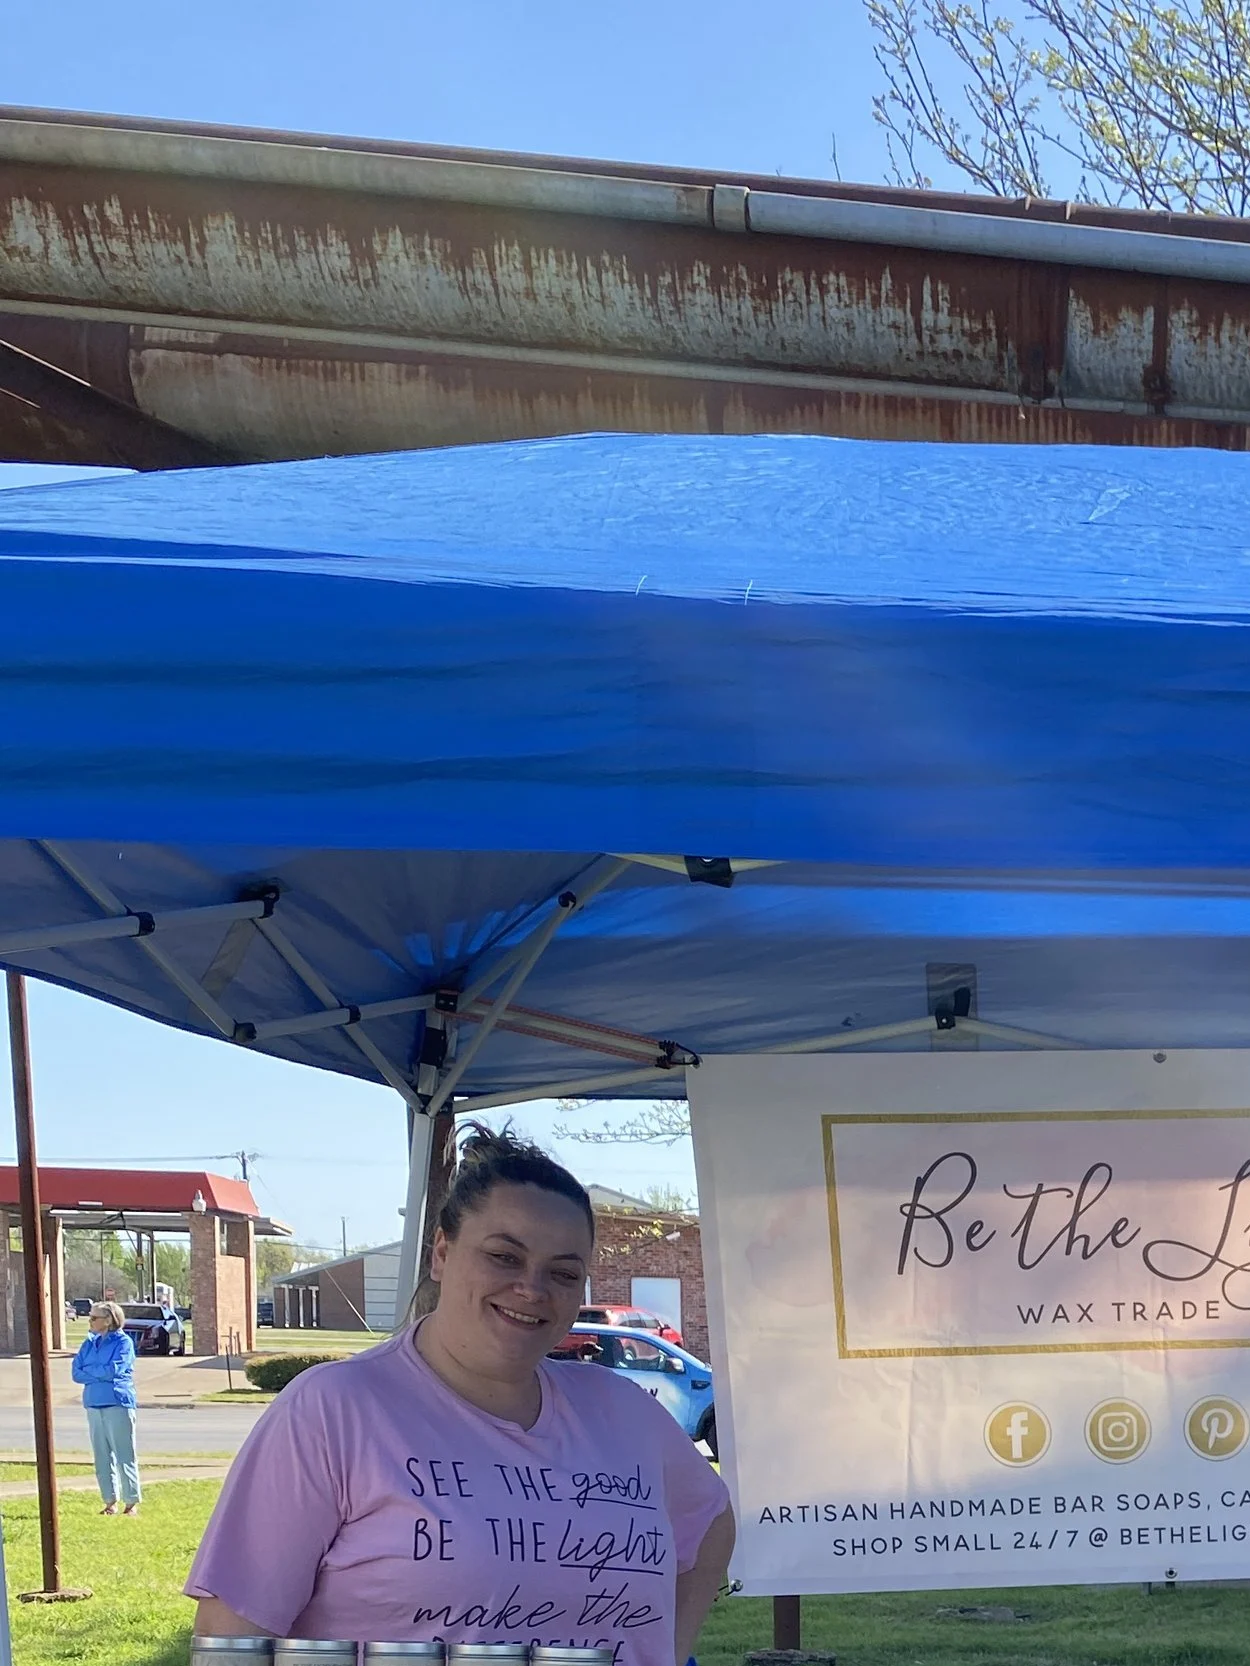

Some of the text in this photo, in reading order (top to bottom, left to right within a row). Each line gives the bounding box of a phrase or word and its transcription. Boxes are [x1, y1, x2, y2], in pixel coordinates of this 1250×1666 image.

[898, 1151, 997, 1275] Be
[1016, 1300, 1221, 1325] WAX TRADE
[406, 1457, 652, 1509] SEE THE good
[758, 1503, 879, 1524] ARTISAN
[889, 1497, 1042, 1520] HANDMADE
[1054, 1495, 1105, 1514] BAR
[1116, 1490, 1211, 1512] SOAPS,
[413, 1518, 667, 1582] BE THE light
[832, 1537, 903, 1557] SHOP
[914, 1533, 1003, 1553] SMALL
[1088, 1526, 1109, 1548] @
[413, 1583, 664, 1630] make the
